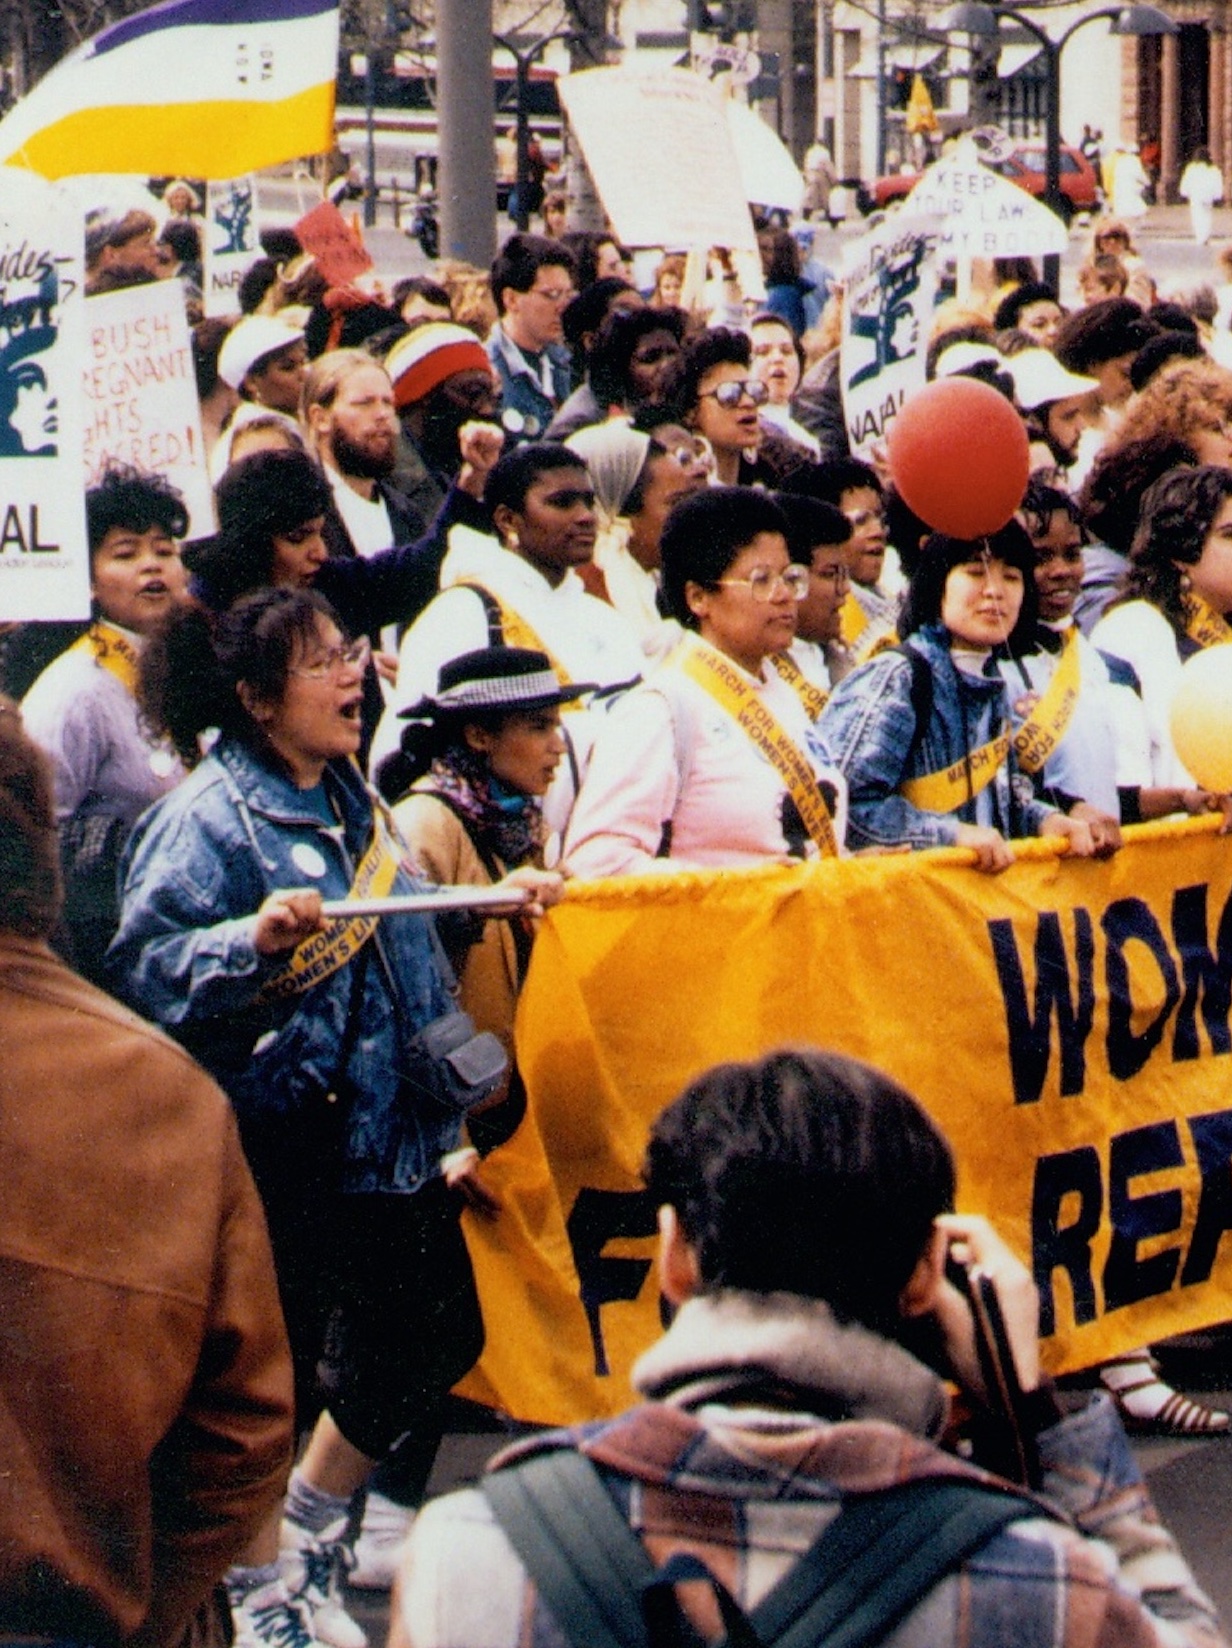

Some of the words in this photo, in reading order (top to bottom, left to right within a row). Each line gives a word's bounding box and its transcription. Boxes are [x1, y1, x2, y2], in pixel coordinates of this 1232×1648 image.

[937, 170, 997, 195] KEEP
[92, 314, 171, 358] BUSH
[697, 651, 747, 697] MARCH
[746, 699, 775, 732] FOR
[800, 682, 829, 709] FOR
[738, 710, 799, 790] WOMEN'S
[1026, 734, 1055, 764] FOR
[947, 752, 990, 783] MACH
